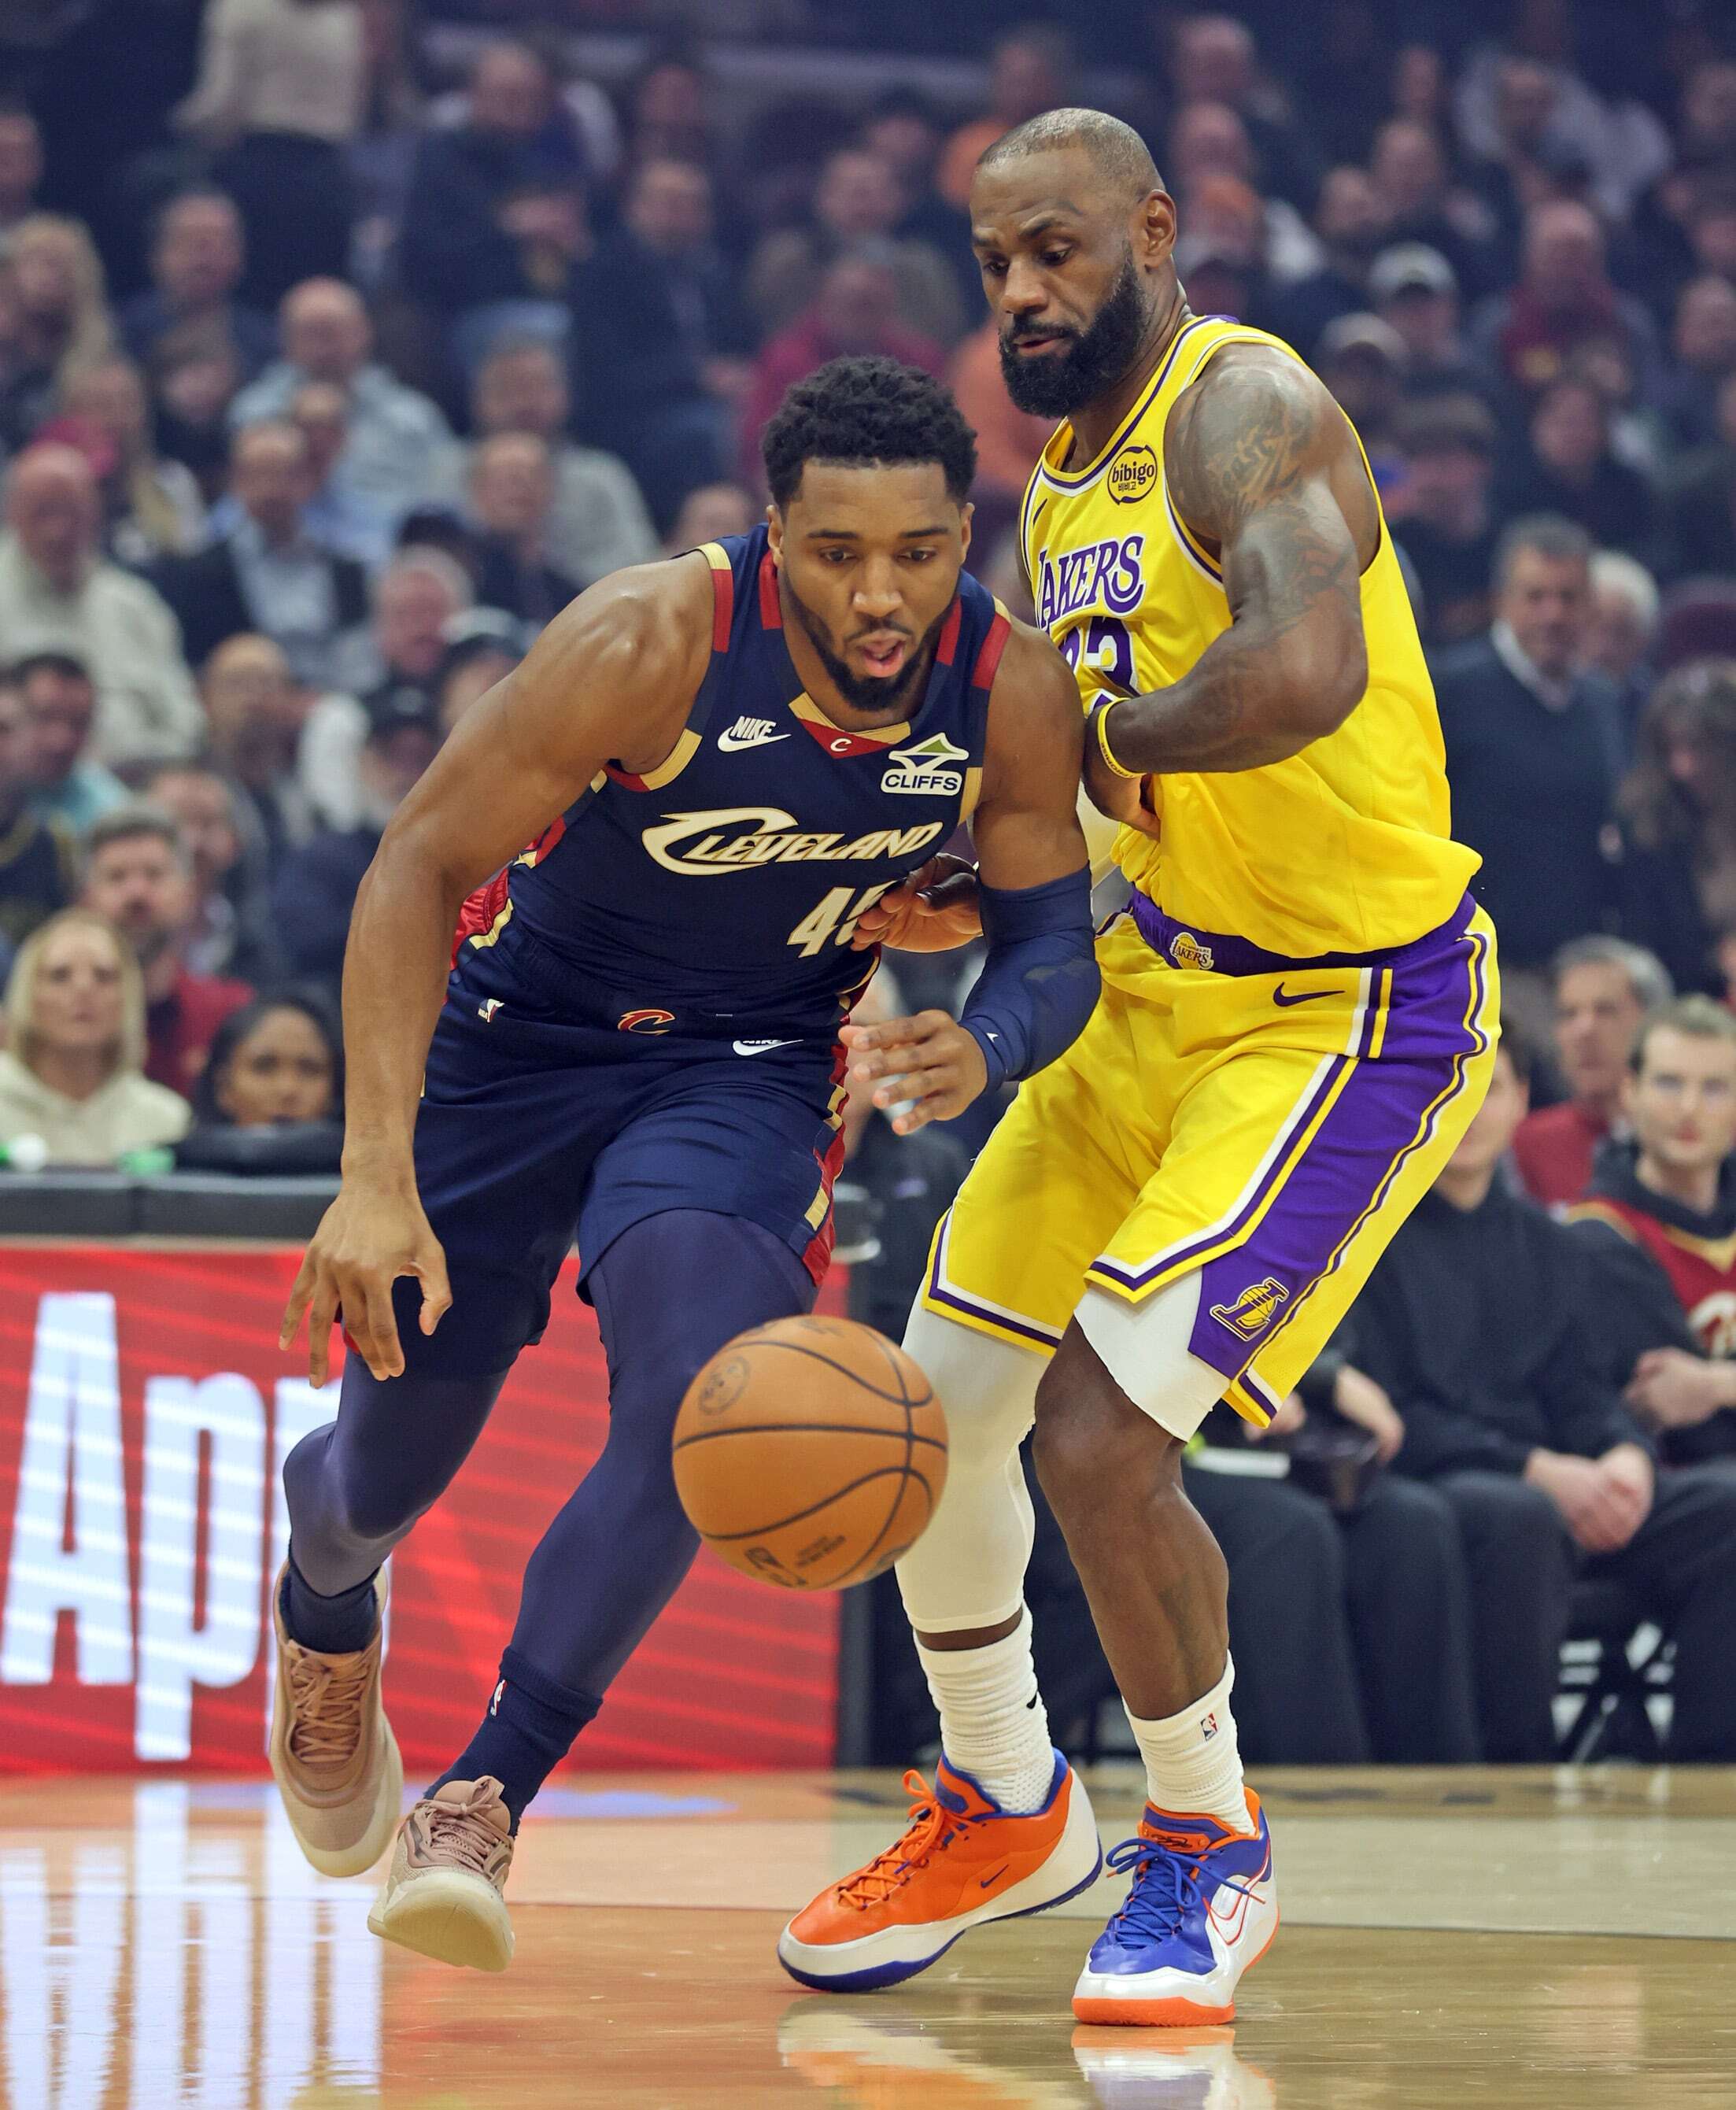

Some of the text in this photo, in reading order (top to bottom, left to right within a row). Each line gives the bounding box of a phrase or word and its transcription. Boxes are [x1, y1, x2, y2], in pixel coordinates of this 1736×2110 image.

[1112, 461, 1154, 485] bibigo
[1118, 481, 1136, 492] 비비고
[730, 716, 776, 740] NIKE
[885, 774, 958, 791] CLIFFS
[642, 807, 943, 875] CLEVELAND
[1173, 939, 1213, 969] LAKERS
